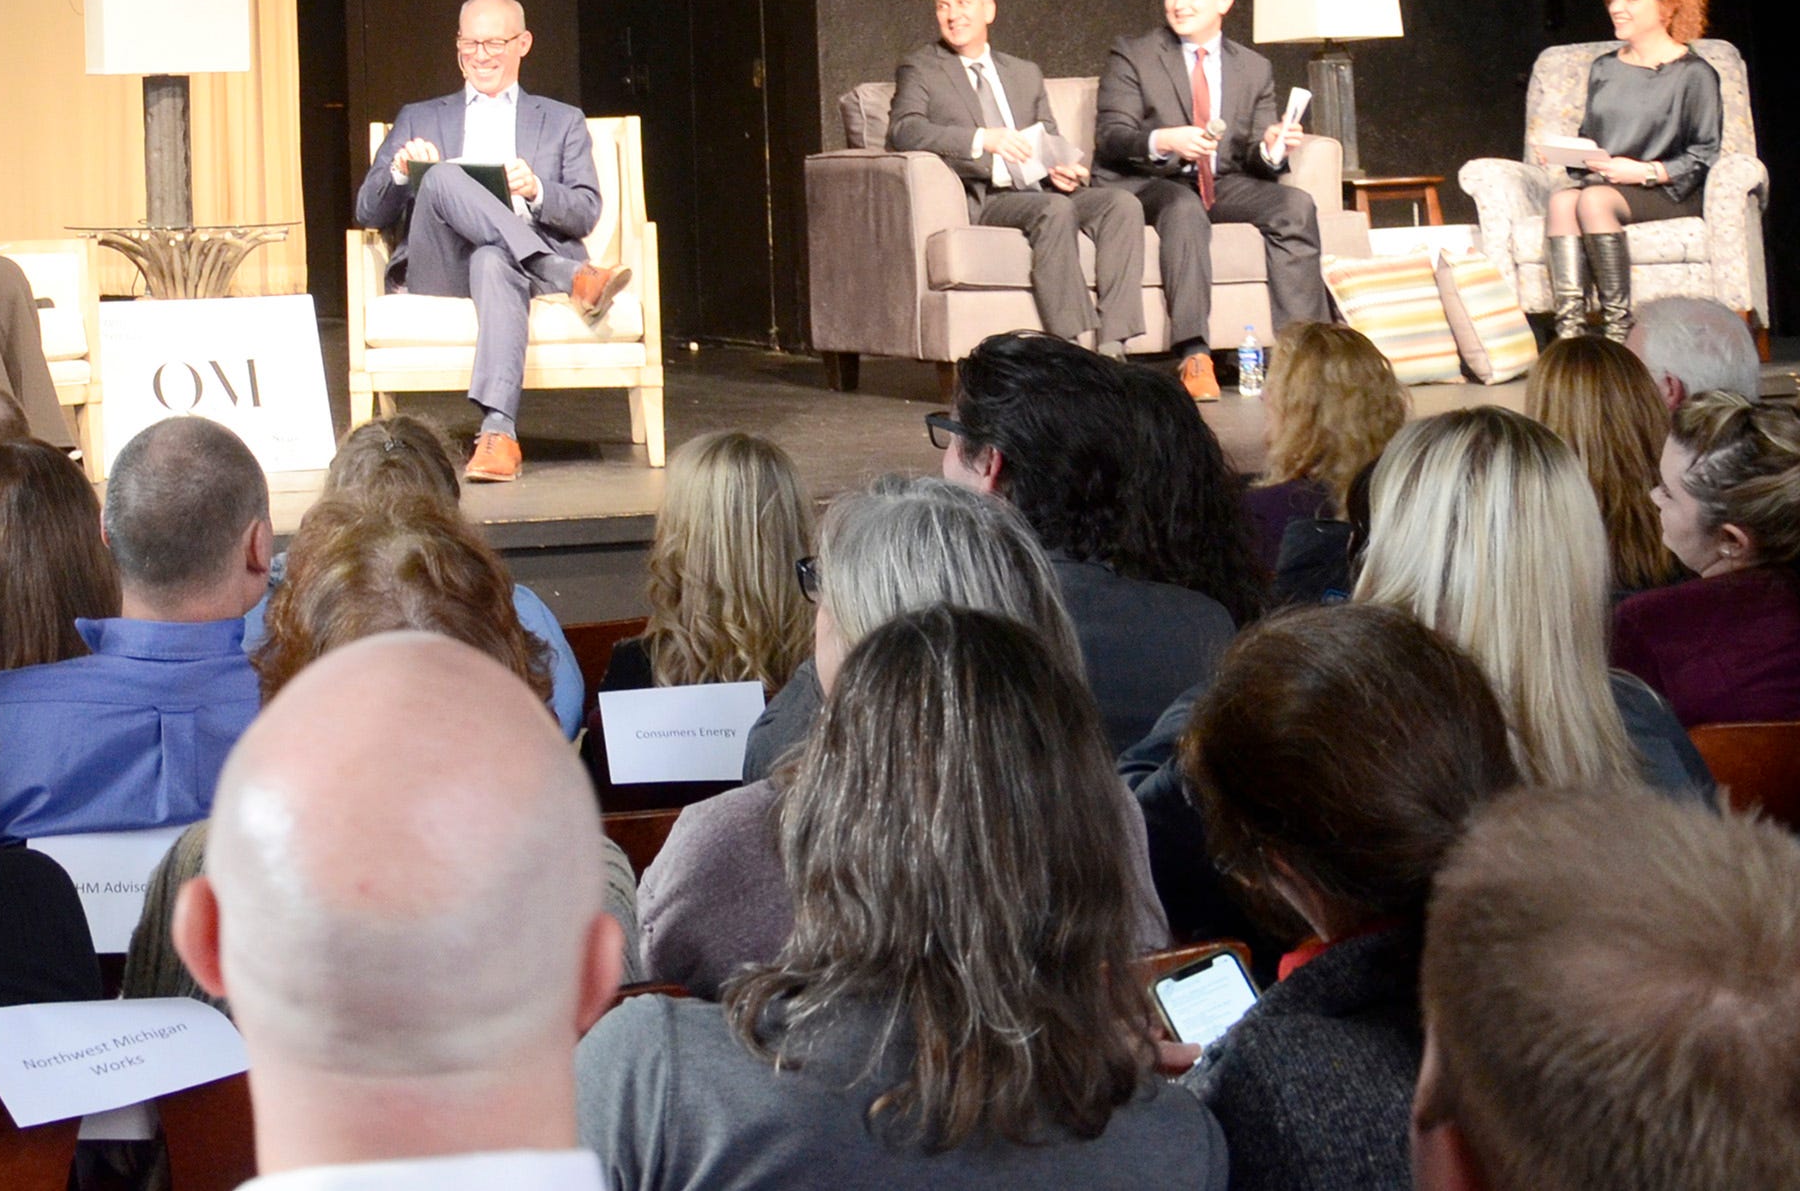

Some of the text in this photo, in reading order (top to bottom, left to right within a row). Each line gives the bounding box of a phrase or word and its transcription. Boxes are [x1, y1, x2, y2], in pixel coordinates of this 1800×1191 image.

[635, 727, 737, 740] Consumers Energy
[22, 1021, 188, 1071] Northwest Michigan
[90, 1054, 145, 1077] Works
